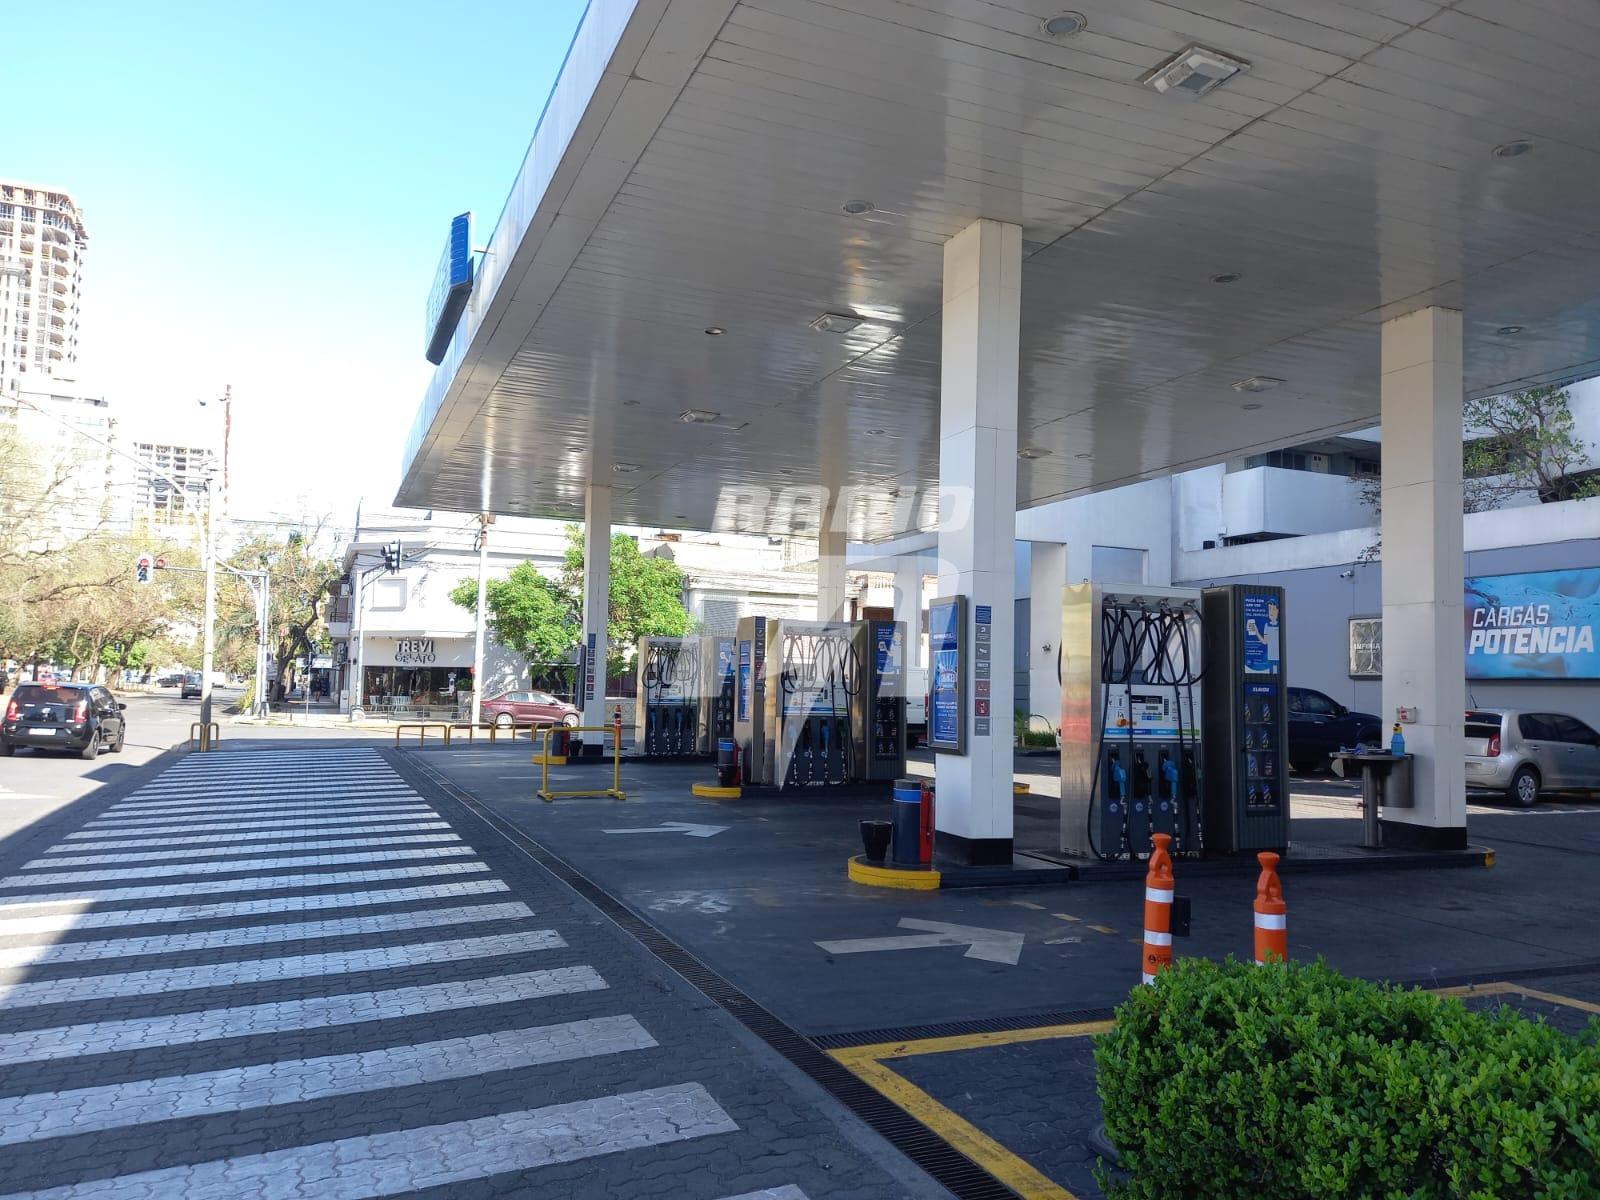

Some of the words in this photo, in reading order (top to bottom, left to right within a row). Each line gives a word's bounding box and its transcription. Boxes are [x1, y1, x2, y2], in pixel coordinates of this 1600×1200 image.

[1472, 602, 1550, 627] CARGÁS
[395, 640, 434, 653] TREVI
[1468, 625, 1594, 655] POTENCIA
